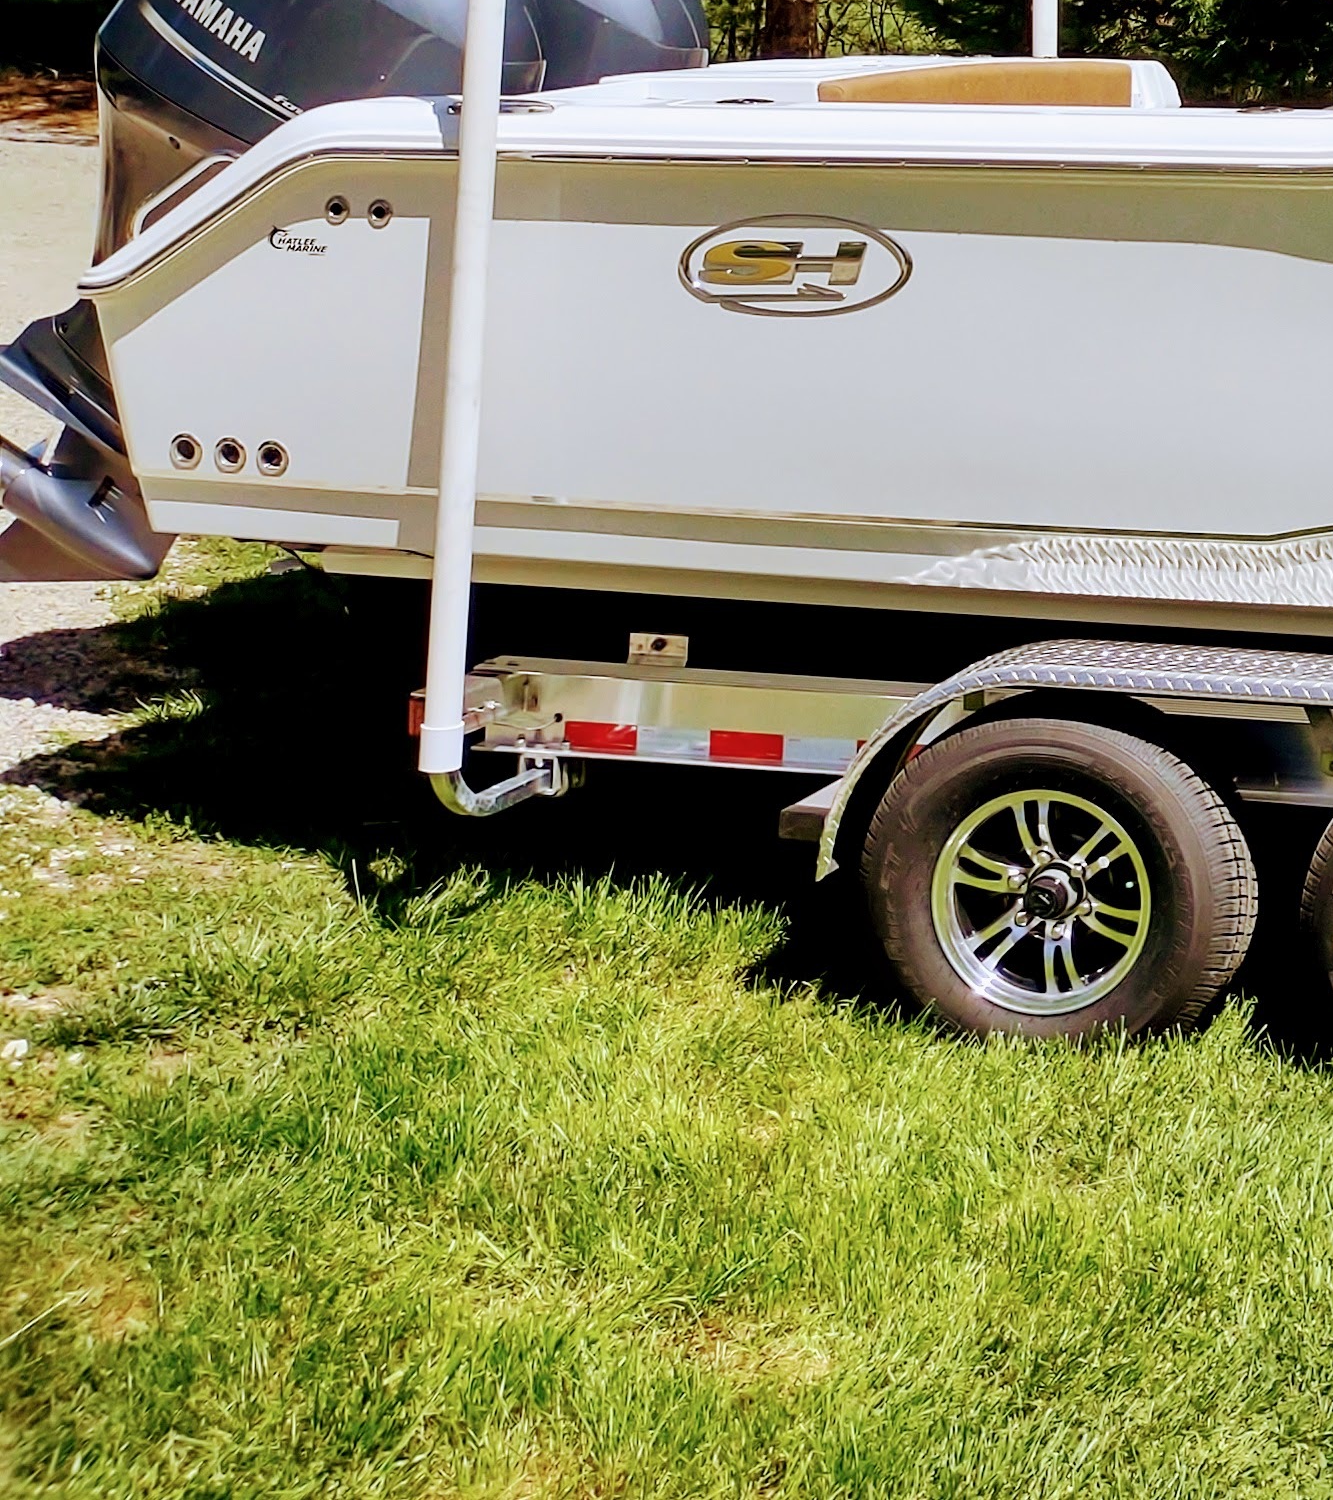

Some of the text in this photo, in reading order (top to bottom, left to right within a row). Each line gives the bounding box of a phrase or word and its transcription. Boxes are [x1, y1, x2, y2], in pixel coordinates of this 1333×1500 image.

[268, 225, 317, 250] CHATLEE
[286, 244, 328, 253] MARINE
[698, 239, 867, 285] SH
